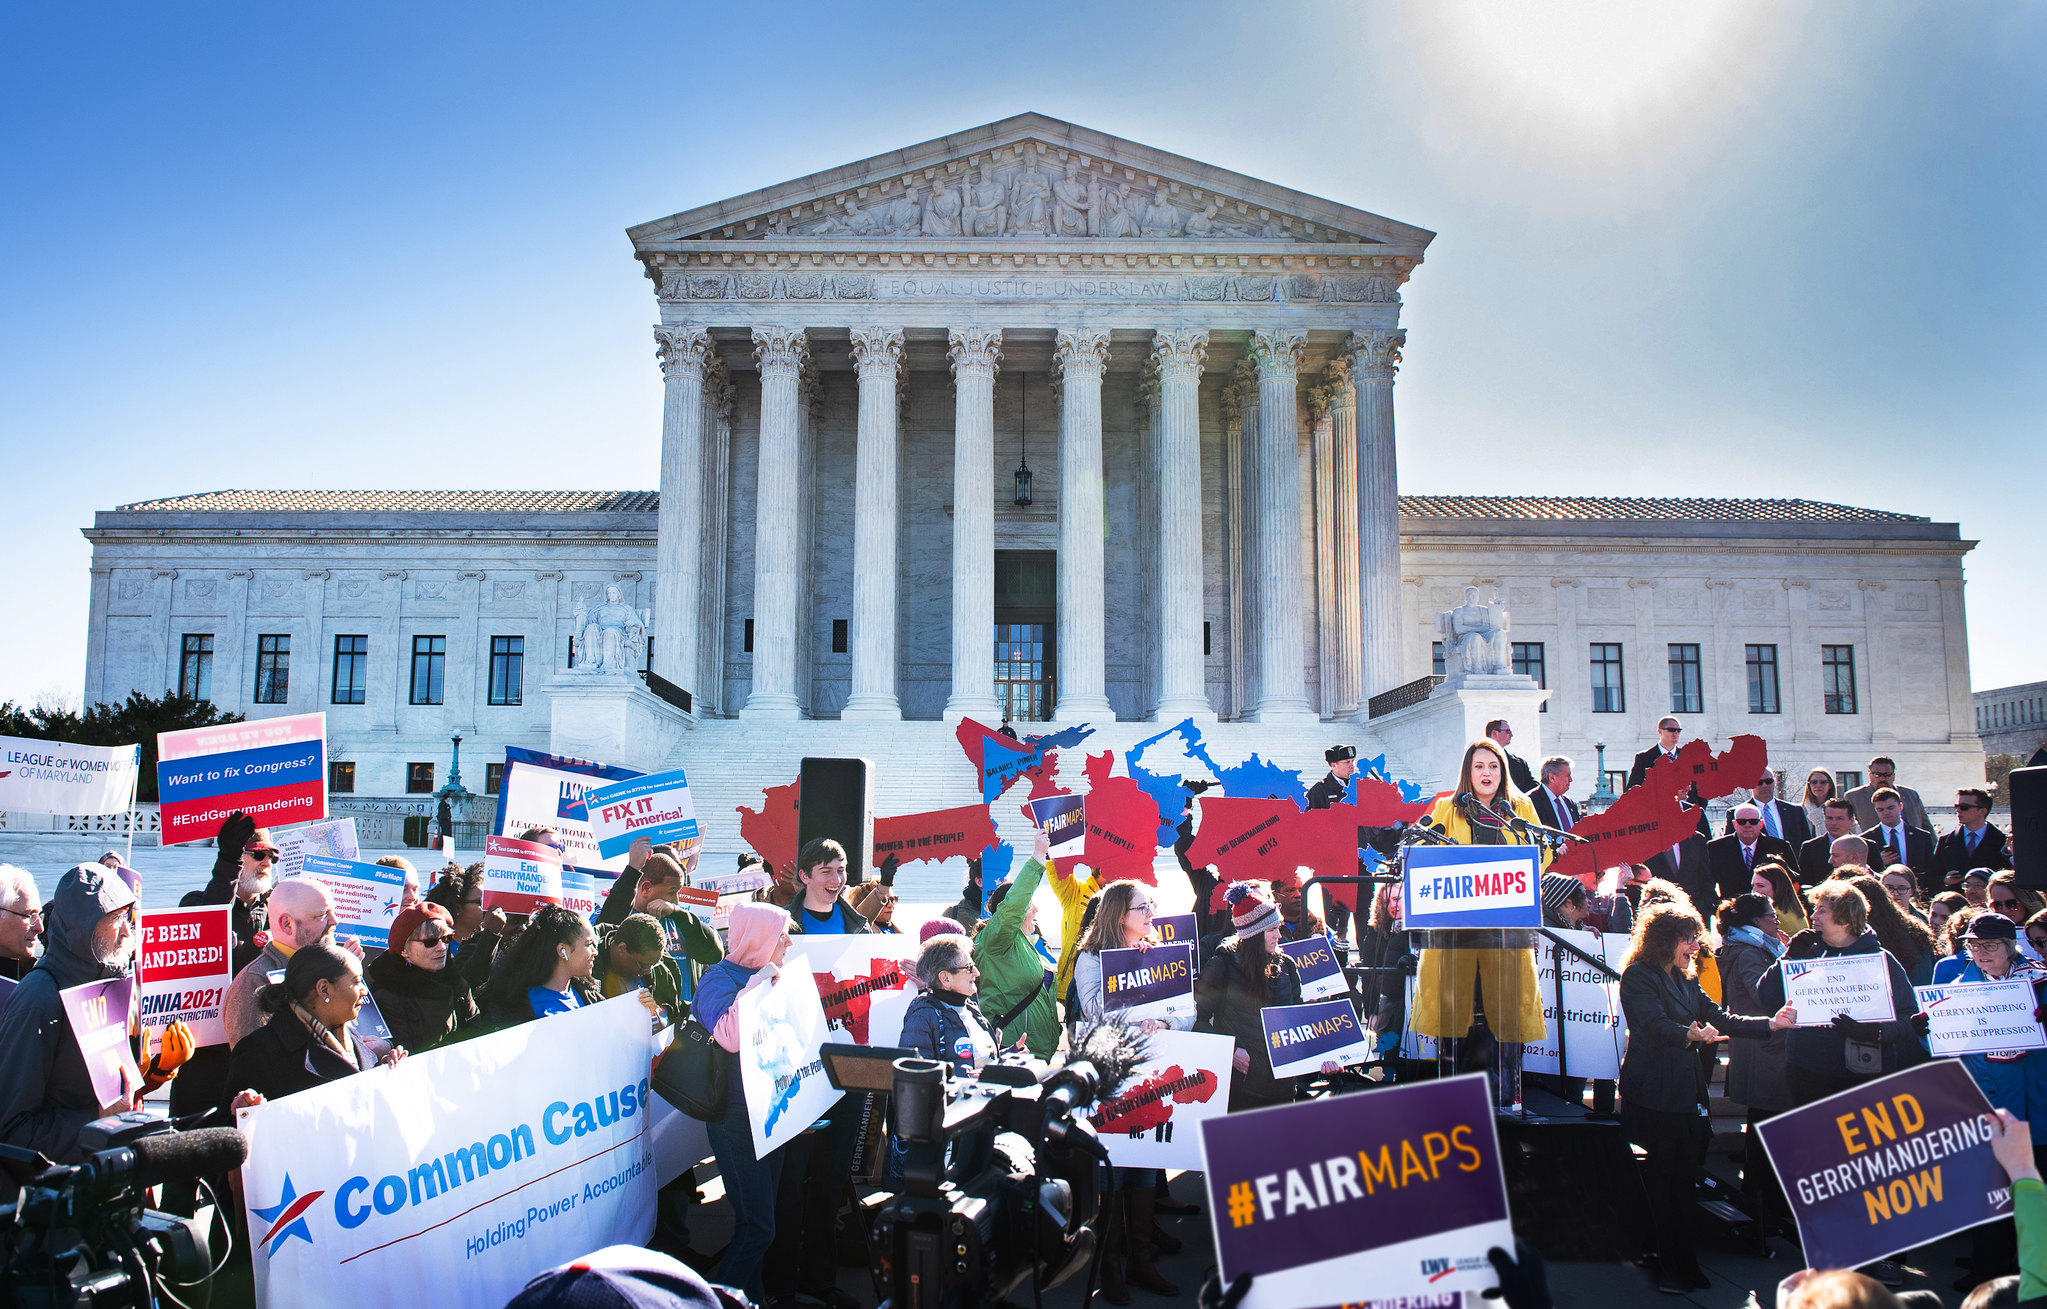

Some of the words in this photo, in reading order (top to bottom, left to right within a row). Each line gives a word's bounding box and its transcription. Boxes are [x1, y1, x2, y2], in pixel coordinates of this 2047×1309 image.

[891, 280, 957, 297] EQUAL
[964, 280, 1043, 297] JUSTICE
[1054, 280, 1119, 297] UNDER
[1129, 281, 1169, 297] LAW
[8, 751, 54, 767] LEAGUE
[55, 759, 68, 769] OF
[69, 759, 110, 772] WOMEN
[168, 771, 204, 787] Want
[207, 770, 220, 781] to
[224, 766, 241, 778] fix
[244, 755, 315, 775] Congress?
[20, 766, 35, 778] OF
[36, 769, 94, 784] MARYLAND
[602, 801, 635, 824] FIX
[636, 797, 653, 814] IT
[625, 806, 684, 830] America!
[1043, 807, 1084, 834] #FAIRMAPS
[561, 828, 595, 840] WOMEN
[875, 842, 903, 853] POWER
[906, 840, 916, 849] TO
[917, 836, 932, 847] THE
[933, 831, 965, 845] PEOPLE!
[1089, 824, 1104, 836] THE
[1104, 830, 1135, 853] PEOPLE!
[520, 862, 538, 873] End
[341, 882, 363, 891] support
[517, 881, 541, 893] Now!
[1419, 870, 1527, 900] #FAIRMAPS
[345, 890, 378, 901] redistricting
[158, 923, 201, 943] BEEN
[142, 945, 223, 970] ANDERED!
[1107, 960, 1187, 994] #FAIRMAPS
[1786, 962, 1807, 975] LWV
[1827, 974, 1846, 983] END
[1795, 983, 1880, 996] GERRYMANDERING
[1920, 989, 1944, 1003] LWV
[1819, 995, 1871, 1006] MARYLAND
[1932, 1002, 2027, 1018] GERRYMANDERING
[159, 1008, 219, 1026] REDISTRICTING
[1830, 1008, 1852, 1016] NOW
[1271, 1014, 1354, 1049] #FAIRMAPS
[1977, 1018, 1988, 1026] IS
[1934, 1030, 1969, 1040] VOTER
[1970, 1025, 2037, 1038] SUPPRESSION
[1106, 1071, 1206, 1122] GERRYMANDERING
[1129, 1125, 1145, 1139] NC
[1835, 1093, 1925, 1155] END
[333, 1121, 535, 1230] Common
[542, 1076, 650, 1146] Cause
[1796, 1113, 1993, 1205] GERRYMANDERING
[1226, 1124, 1482, 1229] #FAIRMAPS
[1862, 1165, 1943, 1225] NOW
[1987, 1187, 2011, 1205] LWV
[466, 1217, 526, 1260] Holding
[527, 1193, 578, 1229] Power
[582, 1151, 652, 1204] Accountable
[1420, 1257, 1450, 1276] LWV
